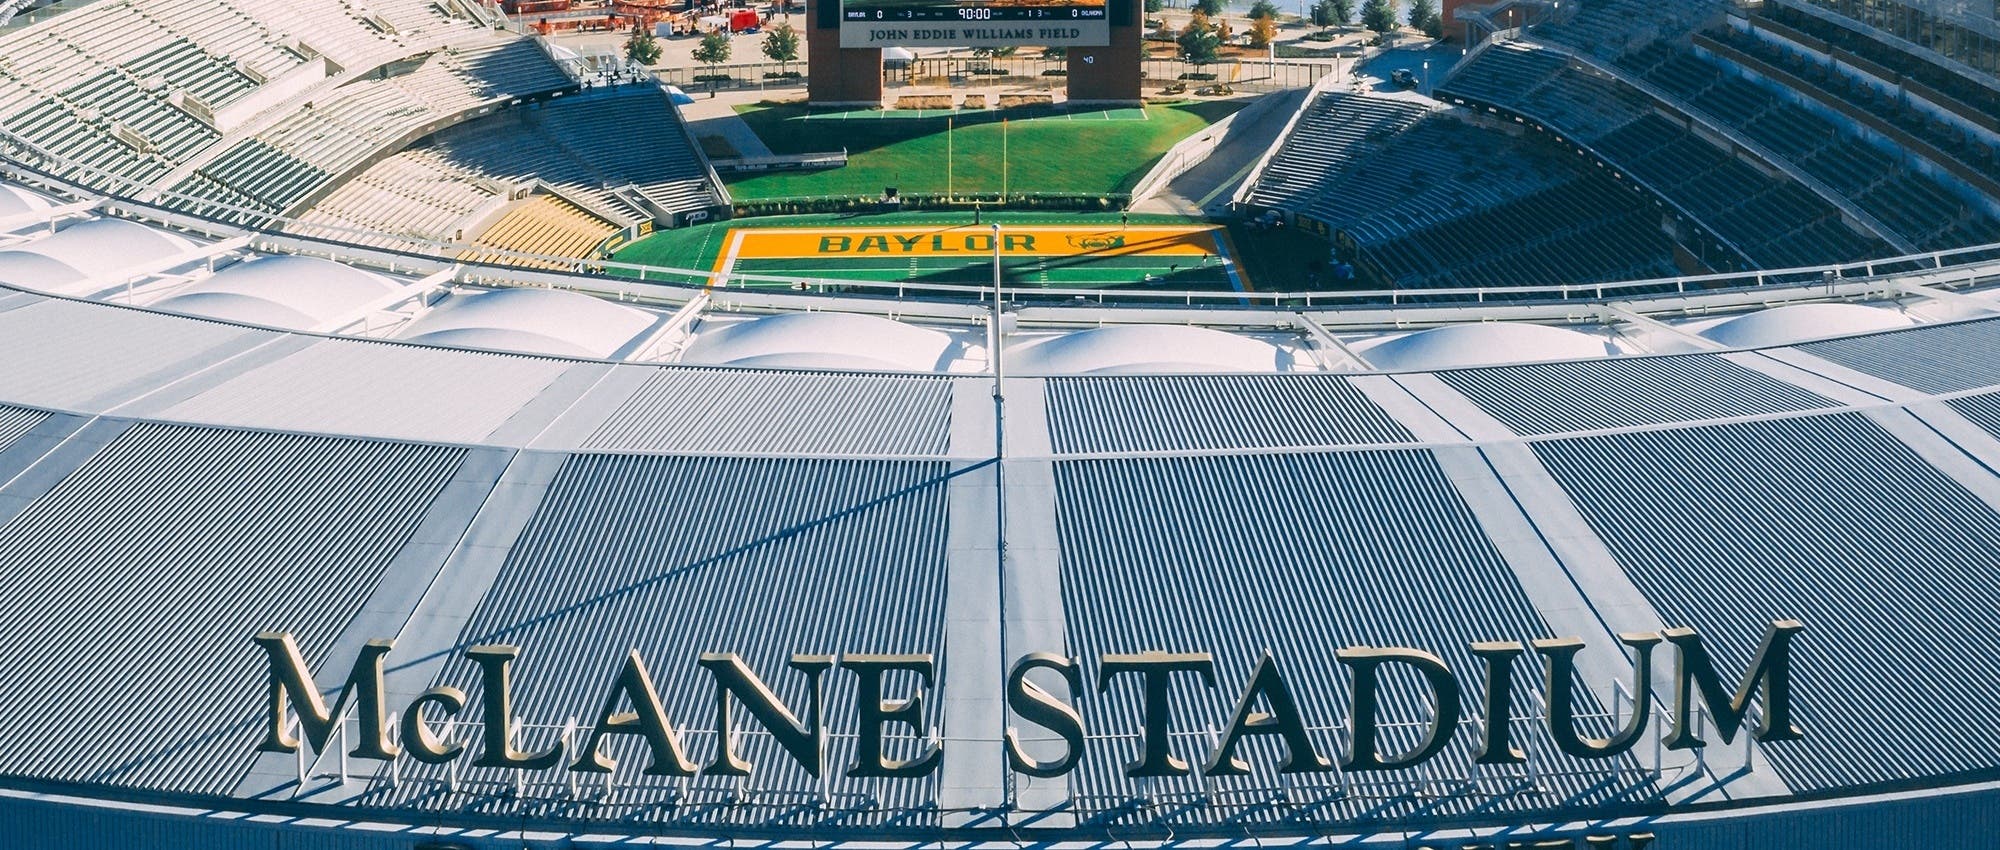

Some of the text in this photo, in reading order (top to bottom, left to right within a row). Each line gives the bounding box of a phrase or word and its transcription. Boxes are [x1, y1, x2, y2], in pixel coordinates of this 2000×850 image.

[876, 10, 883, 19] 0
[958, 8, 991, 20] 90:00
[1071, 9, 1078, 18] 0
[869, 28, 1080, 41] JOHN EDDIE WILLIAMS FIELD
[1083, 55, 1094, 64] 40
[818, 234, 1037, 253] BAYLOR
[253, 618, 1802, 779] McLANE STADIUM
